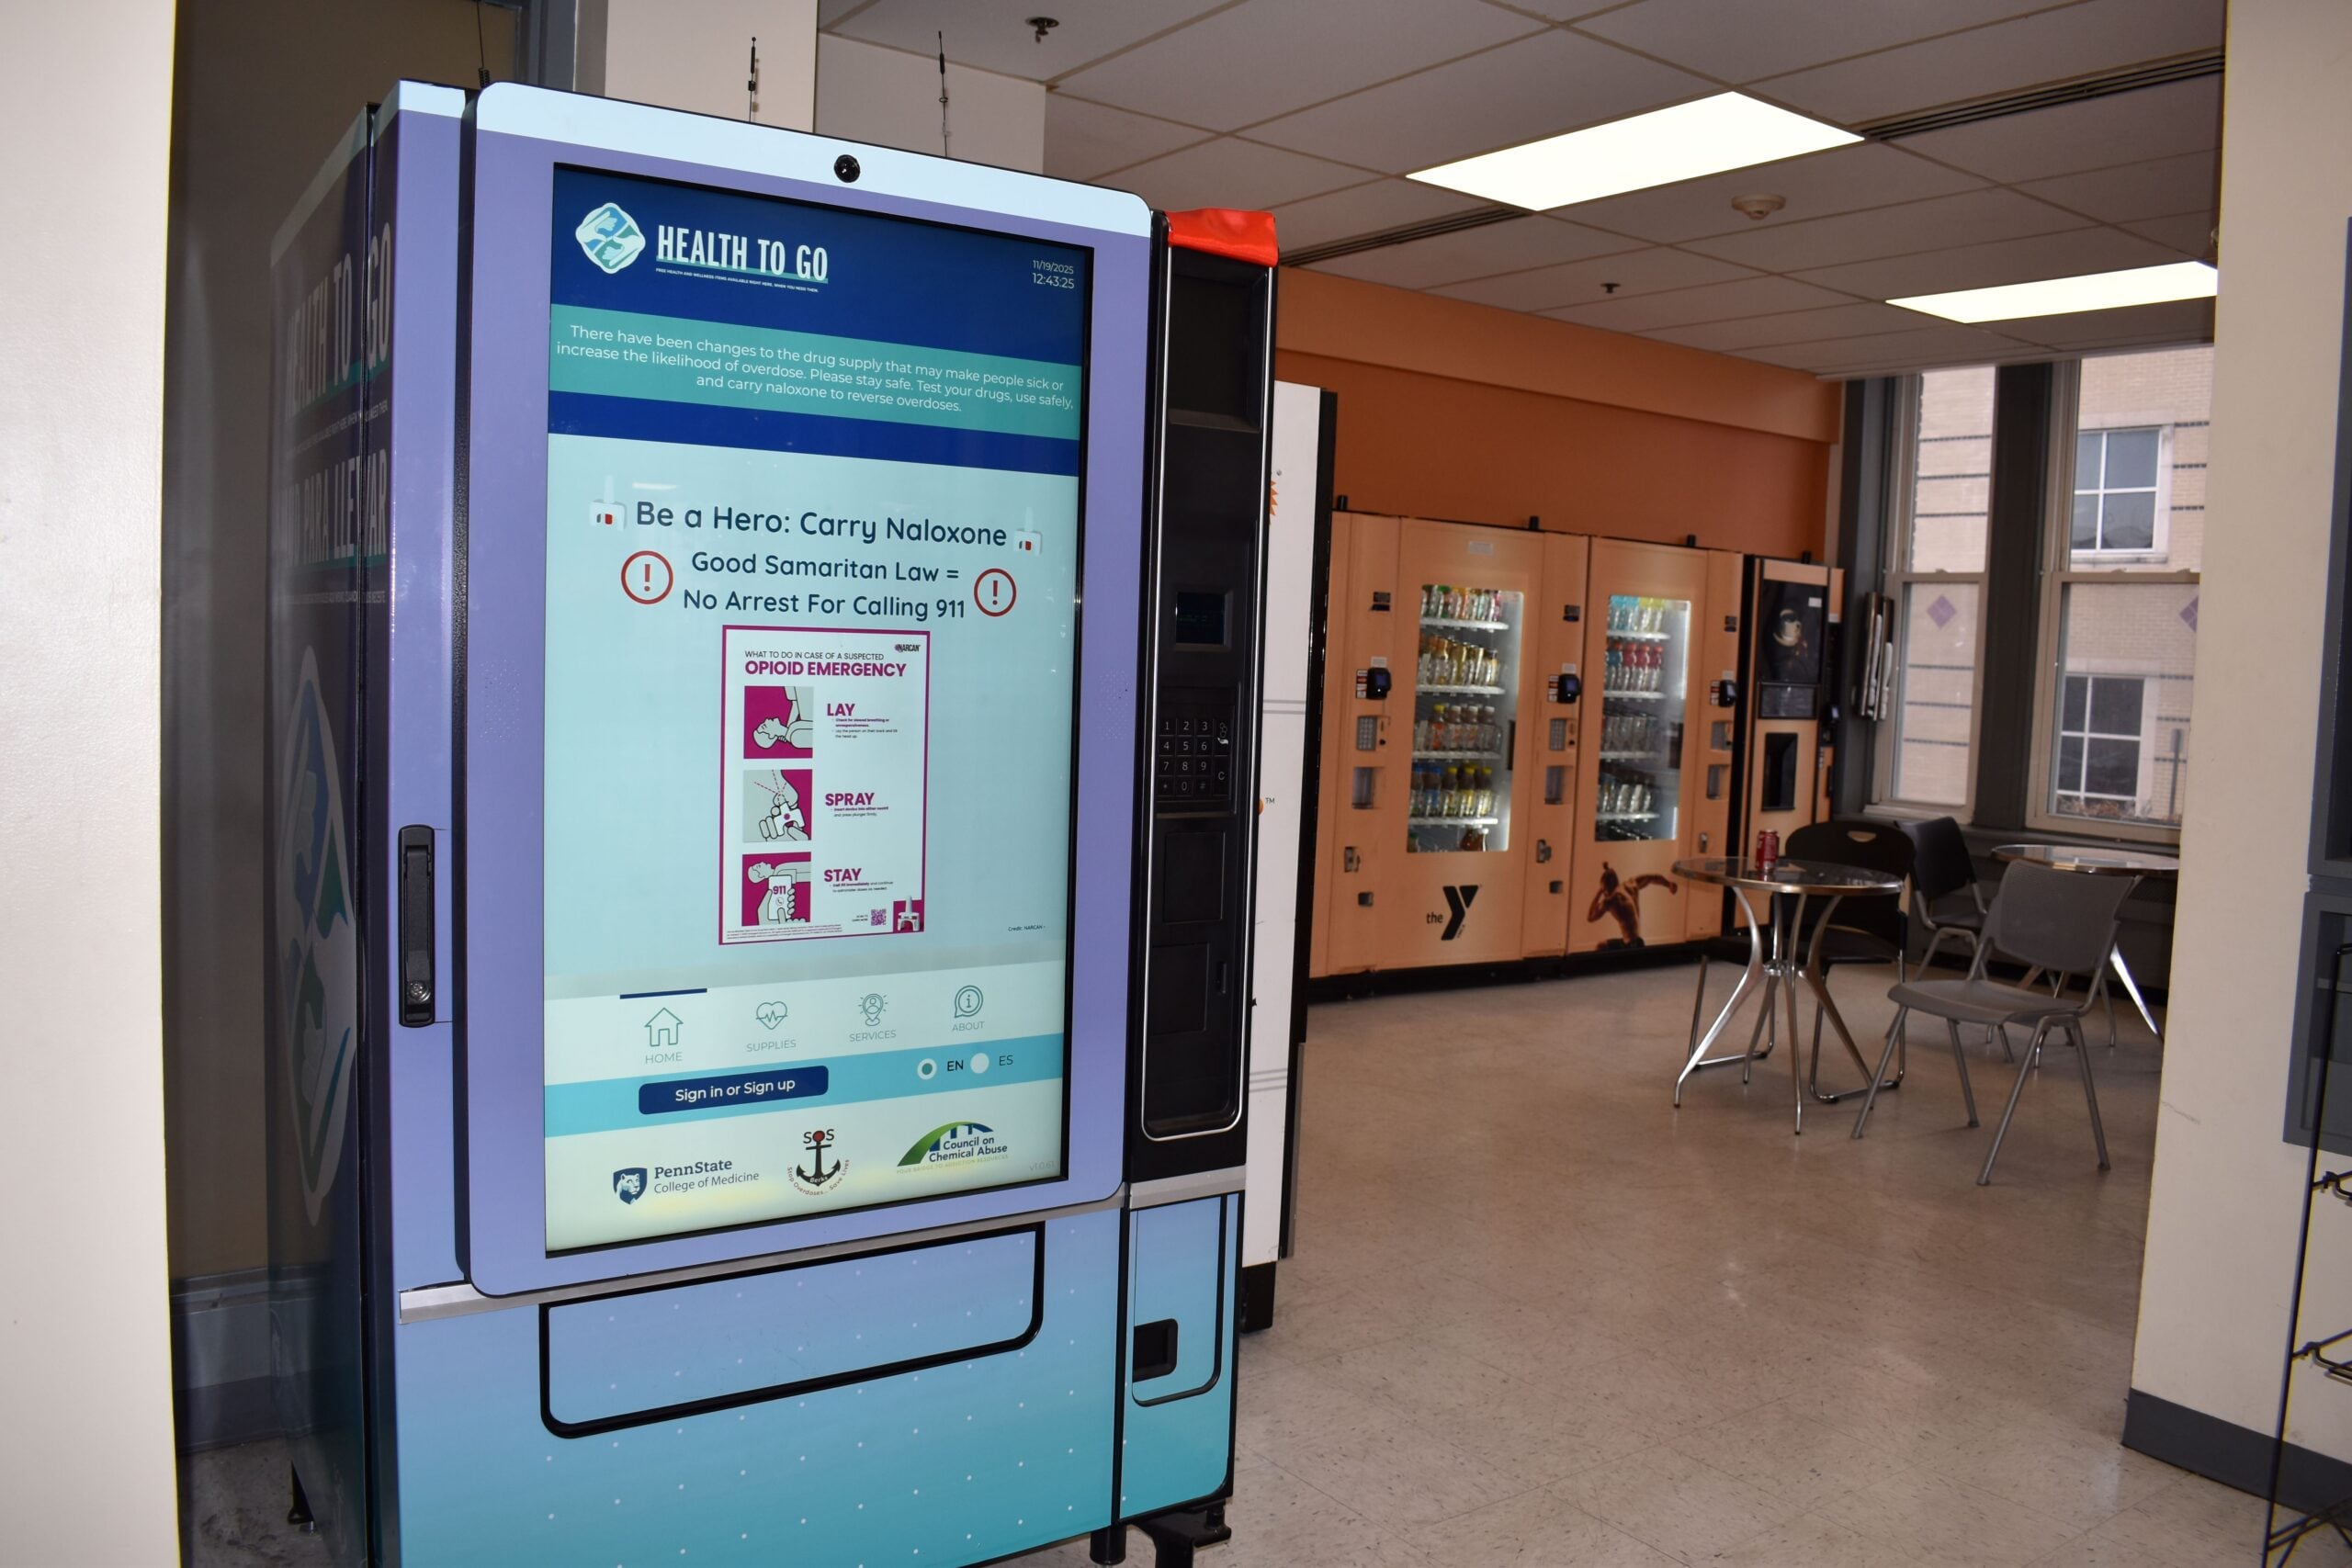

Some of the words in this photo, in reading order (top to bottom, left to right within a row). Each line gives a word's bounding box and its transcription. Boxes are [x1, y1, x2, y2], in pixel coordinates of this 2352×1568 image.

[658, 224, 747, 270] HEALTH
[757, 239, 786, 275] TO
[797, 244, 828, 281] GO
[1032, 259, 1074, 276] 11/19/2025
[1032, 273, 1075, 290] 12:43:25
[333, 253, 353, 387] TO
[571, 324, 614, 341] There
[617, 329, 652, 345] have
[656, 333, 693, 350] been
[696, 339, 756, 358] changes
[760, 346, 774, 358] to
[777, 347, 800, 362] the
[803, 350, 835, 367] drug
[839, 357, 884, 372] supply
[886, 361, 912, 374] that
[915, 366, 943, 379] may
[945, 367, 980, 382] make
[983, 373, 1024, 388] people
[1026, 376, 1049, 390] sick
[1051, 381, 1064, 391] or
[557, 341, 619, 360] increase
[623, 348, 648, 363] the
[652, 351, 720, 370] likelihood
[724, 358, 739, 372] of
[741, 363, 808, 379] overdose.
[810, 368, 853, 384] Please
[855, 375, 881, 389] stay
[885, 378, 913, 390] safe.
[917, 380, 942, 394] Test
[944, 385, 972, 398] your
[975, 386, 1012, 403] drugs,
[1015, 392, 1036, 403] use
[1038, 393, 1073, 411] safely,
[696, 374, 723, 388] and
[727, 378, 763, 394] carry
[766, 382, 827, 398] naloxone
[831, 388, 844, 400] to
[847, 391, 893, 405] reverse
[897, 395, 962, 412] overdoses.
[636, 502, 674, 527] Be
[684, 507, 703, 529] a
[713, 506, 790, 534] Hero:
[800, 512, 876, 544] Carry
[887, 517, 1007, 547] Naloxone
[692, 551, 757, 576] Good
[764, 555, 888, 581] Samaritan
[896, 561, 939, 582] Law
[945, 569, 959, 580] =
[683, 589, 718, 611] No
[725, 591, 799, 614] Arrest
[808, 594, 846, 615] For
[853, 595, 929, 621] Calling
[935, 598, 965, 619] 911
[744, 650, 768, 659] WHAT
[804, 651, 823, 660] CASE
[745, 660, 804, 675] OPIOID
[808, 661, 907, 677] EMERGENCY
[827, 703, 855, 716] LAY
[1165, 721, 1169, 730] 1
[1183, 721, 1190, 730] 2
[1202, 721, 1207, 731] 3
[1163, 741, 1170, 750] 4
[1182, 741, 1189, 750] 5
[1201, 741, 1207, 750] 6
[1163, 761, 1170, 771] 7
[1182, 761, 1188, 771] 8
[1200, 761, 1206, 771] 9
[1218, 772, 1226, 780] C
[825, 792, 875, 807] SPRAY
[823, 868, 862, 882] STAY
[772, 886, 786, 895] 911
[1426, 911, 1443, 924] the
[1441, 885, 1479, 941] Y
[644, 1052, 683, 1065] HOME
[746, 1039, 797, 1053] SUPPLIES
[849, 1029, 897, 1043] SERVICES
[951, 1021, 985, 1032] ABOUT
[946, 1059, 964, 1072] EN
[999, 1055, 1013, 1066] ES
[675, 1089, 706, 1103] Sign
[710, 1086, 723, 1098] in
[726, 1086, 741, 1096] or
[743, 1081, 774, 1095] Sign
[777, 1078, 796, 1092] up
[943, 1136, 979, 1150] Council
[982, 1136, 994, 1145] on
[929, 1147, 974, 1163] Chemical
[978, 1145, 1008, 1156] Abuse
[654, 1179, 695, 1194] College
[698, 1178, 708, 1187] of
[711, 1171, 760, 1186] Medicine
